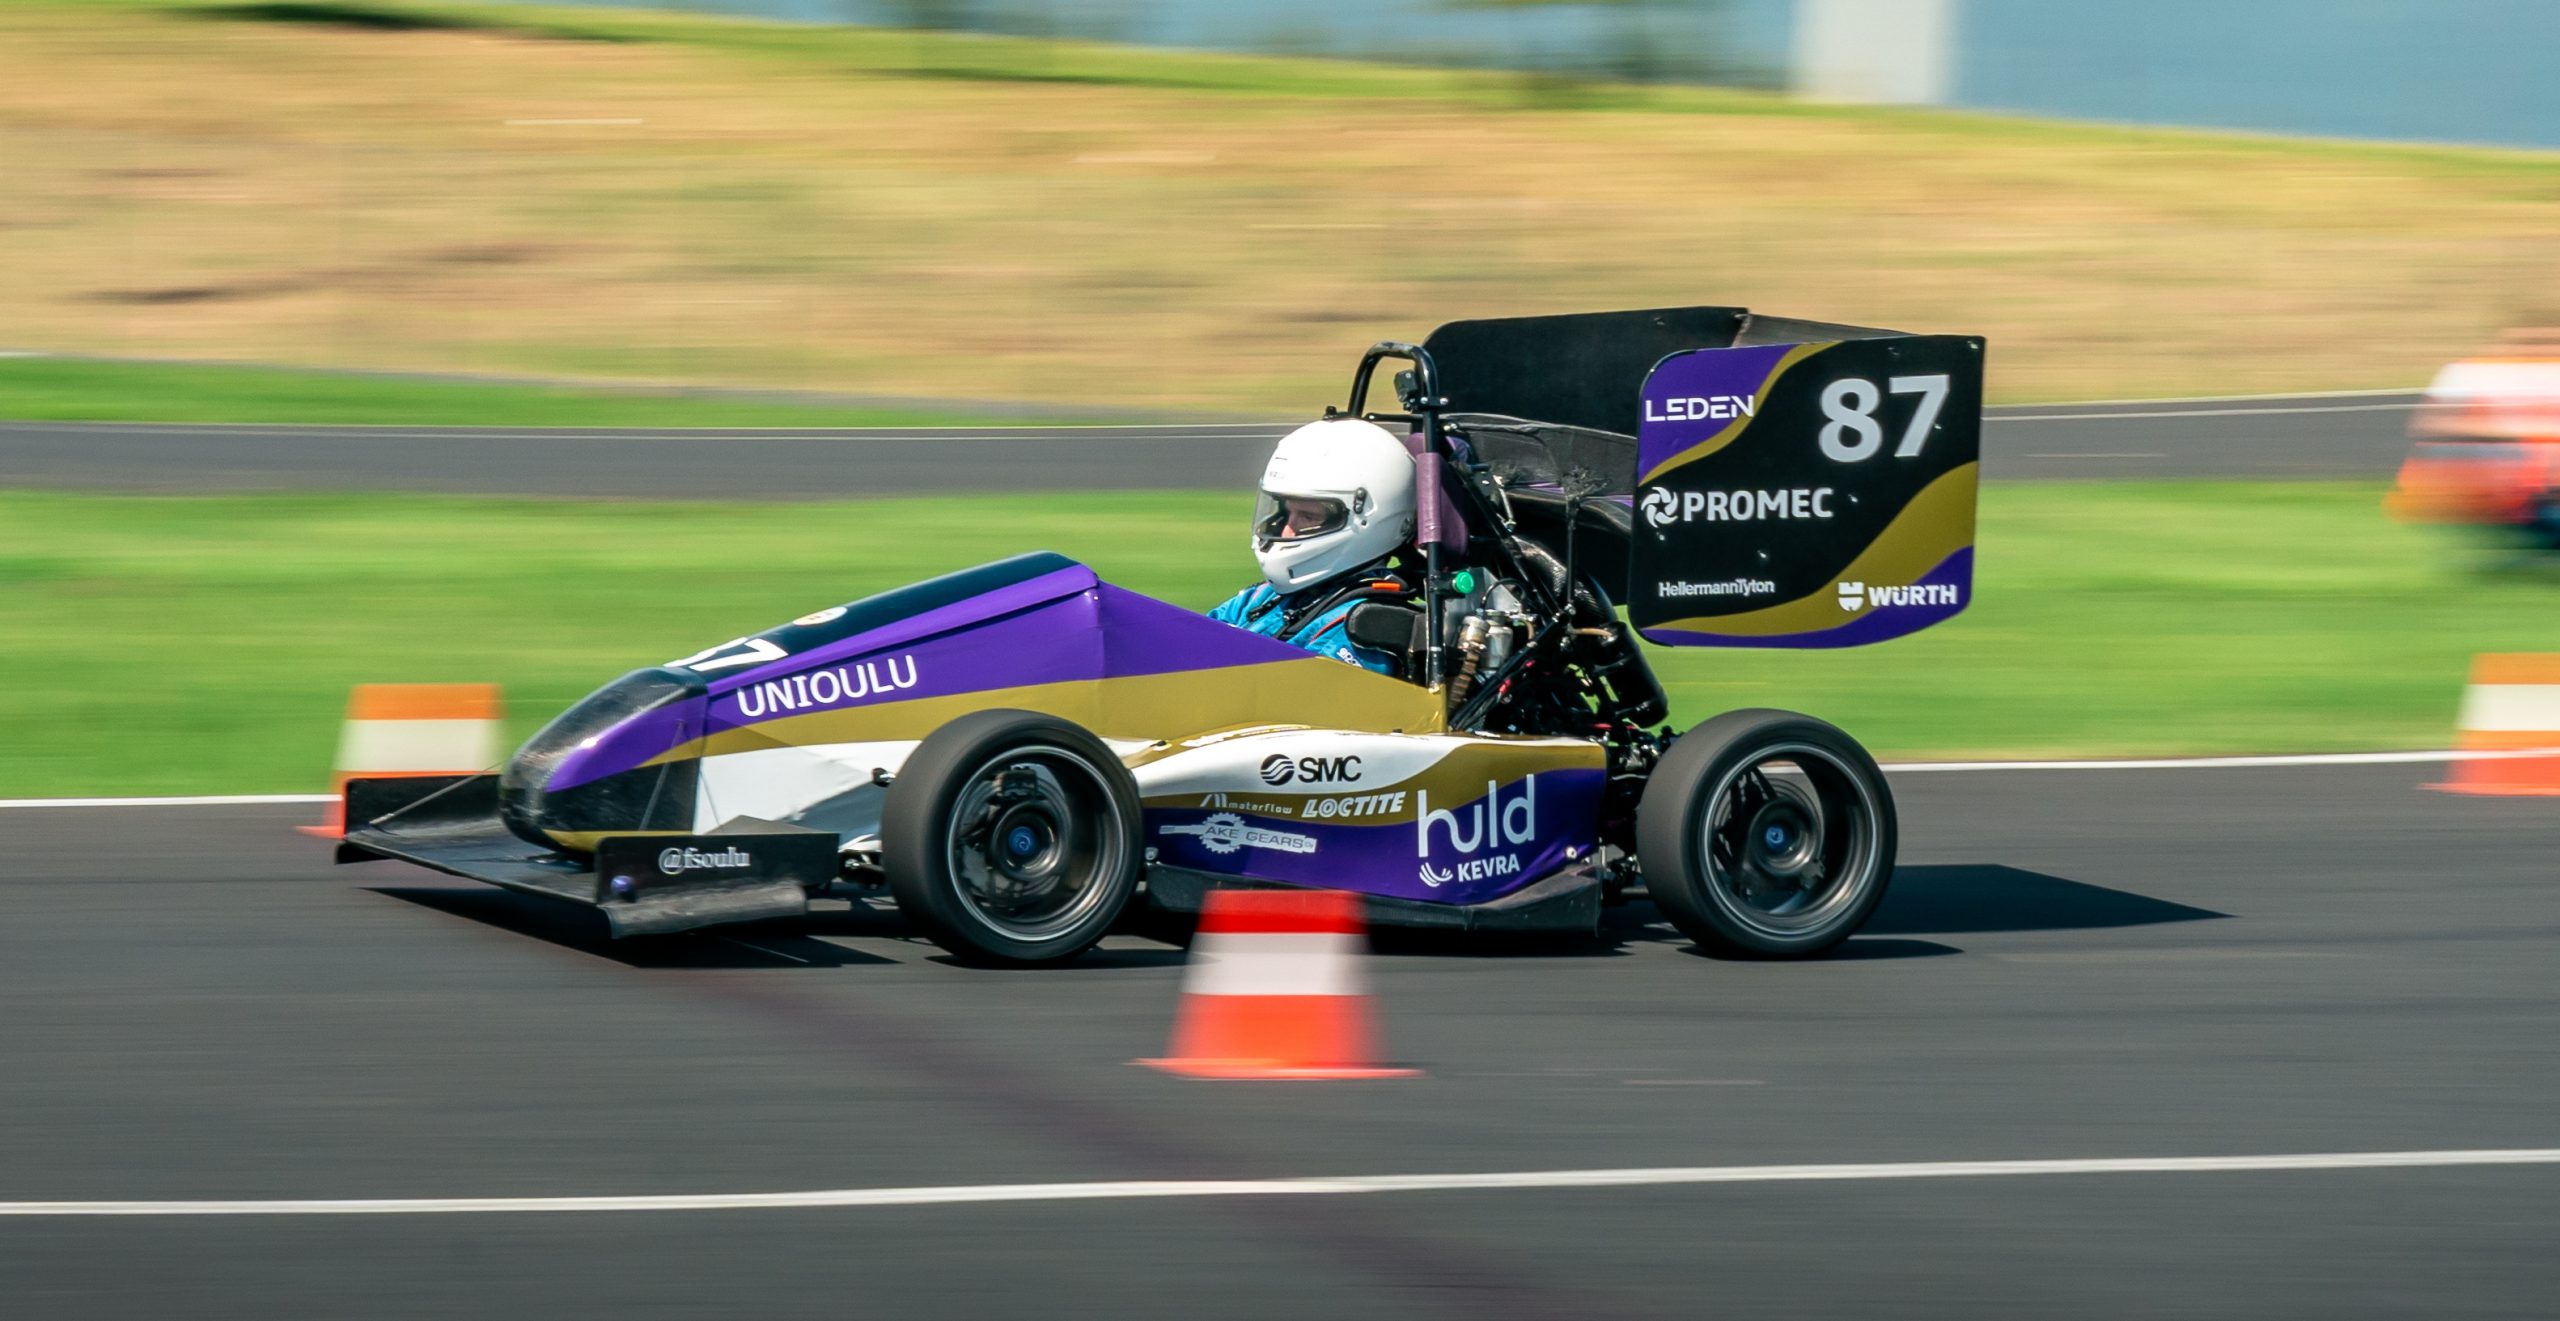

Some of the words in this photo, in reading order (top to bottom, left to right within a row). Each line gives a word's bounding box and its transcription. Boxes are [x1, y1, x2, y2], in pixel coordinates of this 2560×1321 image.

[1645, 395, 1754, 422] LEDEN
[1818, 374, 1950, 463] 87
[1683, 487, 1834, 522] PROMEC
[1658, 578, 1776, 598] HellermannTyton
[1868, 584, 1958, 607] WÜRTH
[736, 654, 918, 717] UNIOULU
[1297, 755, 1363, 784] SMC
[1301, 791, 1406, 819] LOCTITE
[1417, 774, 1536, 859] huld
[1204, 825, 1241, 840] AKE
[1245, 830, 1304, 849] GEARS
[658, 846, 751, 875] @fsoulu
[1457, 854, 1522, 883] KEVRA
